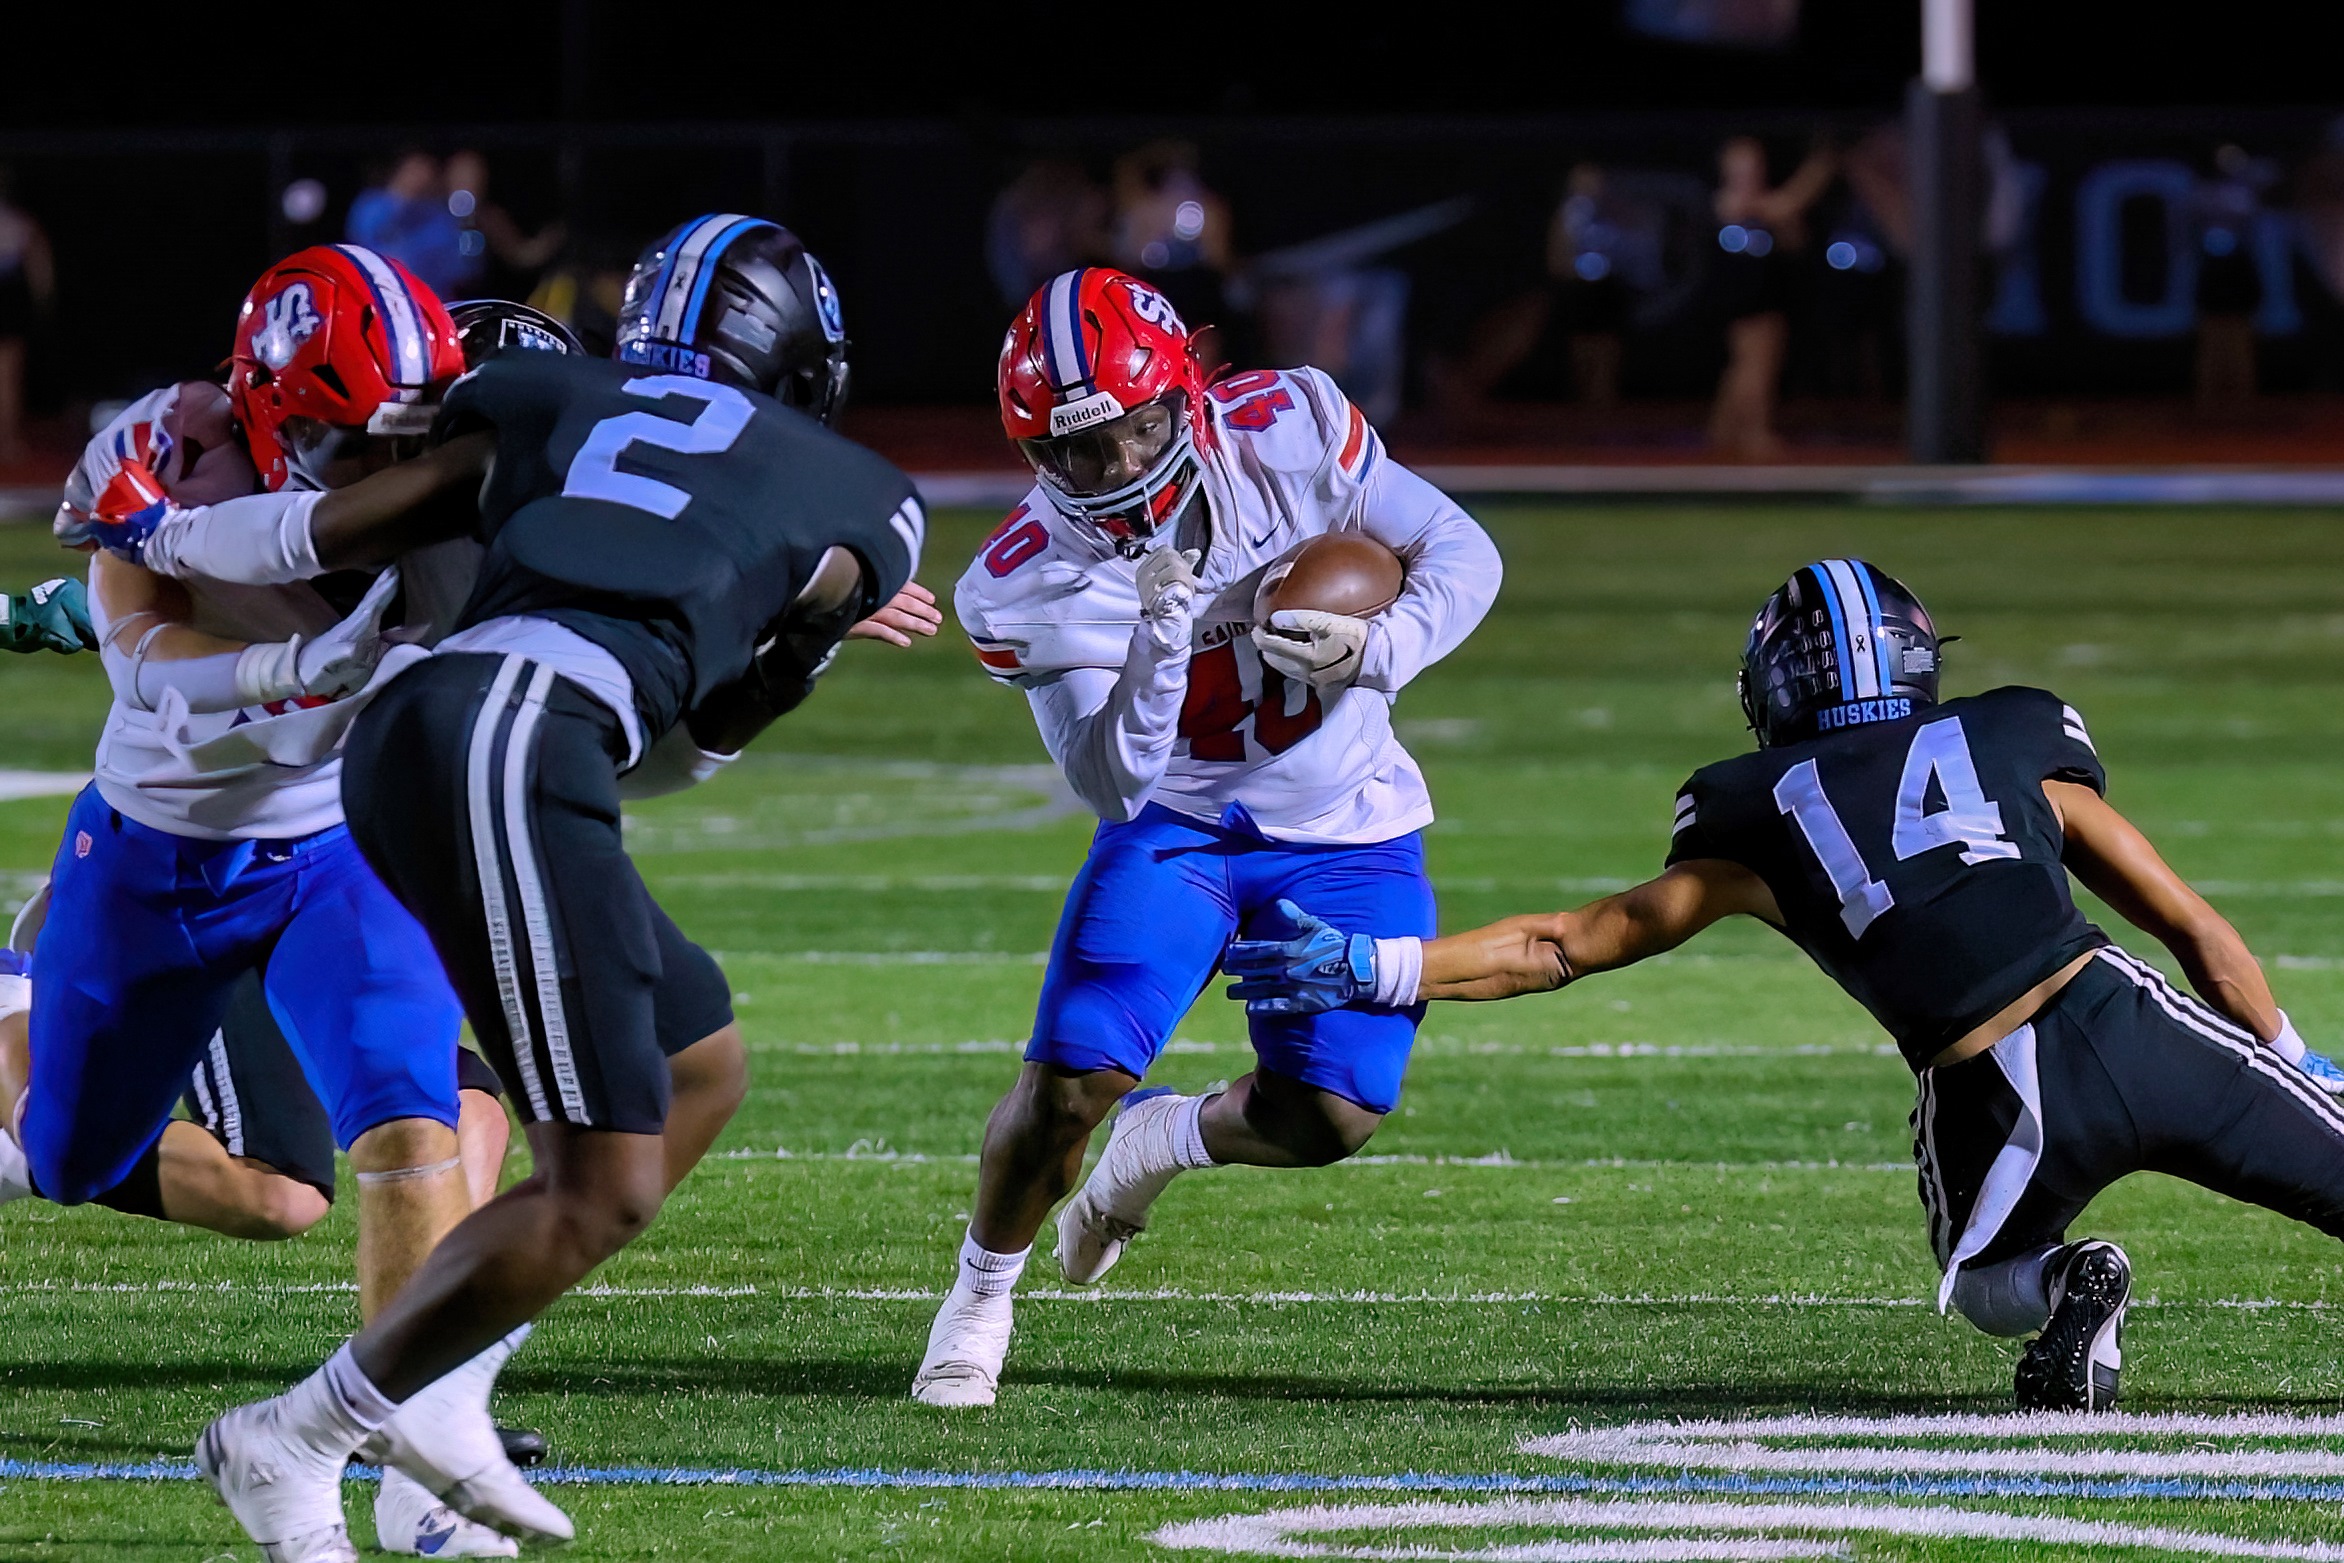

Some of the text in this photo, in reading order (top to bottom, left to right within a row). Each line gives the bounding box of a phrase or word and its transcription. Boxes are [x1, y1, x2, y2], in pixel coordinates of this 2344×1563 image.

[1054, 400, 1112, 429] Riddell
[1208, 369, 1296, 433] 40
[561, 374, 757, 520] 2
[1201, 621, 1250, 645] SAIN
[1177, 640, 1322, 762] 40
[1817, 699, 1911, 732] HUSKIES
[1773, 716, 2021, 941] 14
